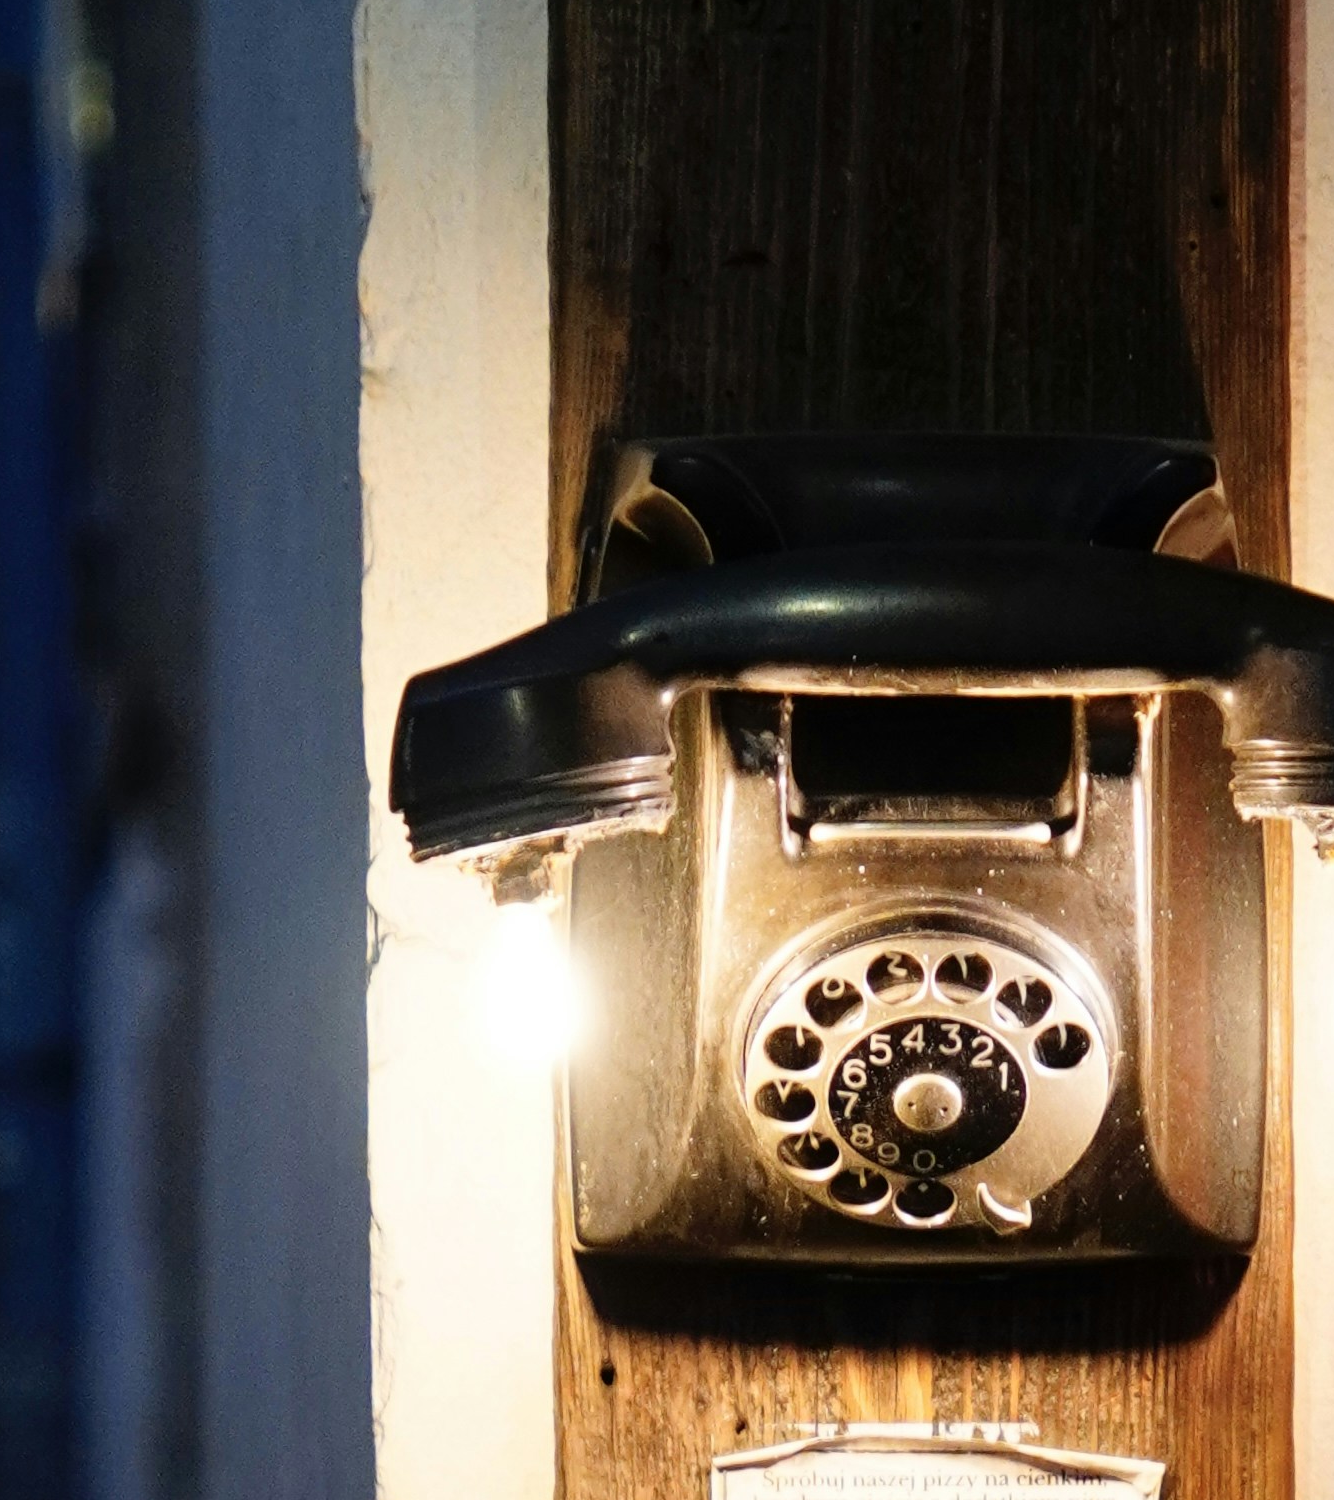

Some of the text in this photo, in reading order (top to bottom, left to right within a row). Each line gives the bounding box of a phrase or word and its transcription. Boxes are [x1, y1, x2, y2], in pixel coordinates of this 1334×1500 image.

[837, 1024, 1008, 1172] 1 2 3 4 5 6 7 8 9 0
[853, 1470, 915, 1491] naszej
[923, 1470, 977, 1490] pizzy
[985, 1473, 1009, 1487] na
